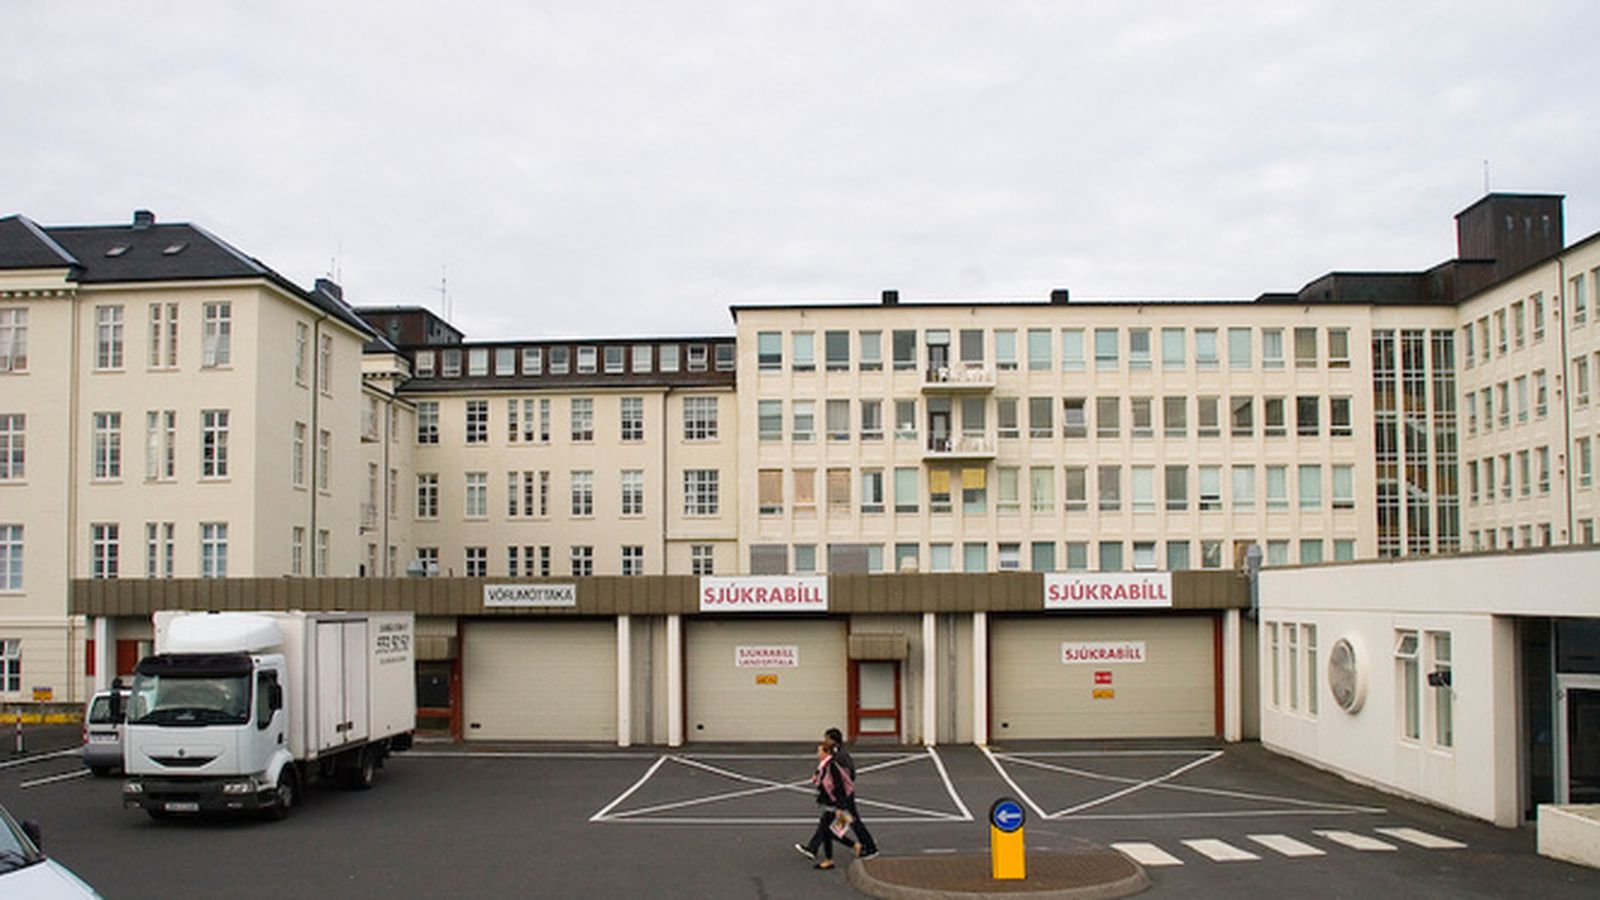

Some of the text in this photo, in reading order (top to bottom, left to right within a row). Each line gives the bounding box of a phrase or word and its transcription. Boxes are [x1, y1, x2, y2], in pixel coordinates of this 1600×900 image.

[703, 581, 824, 604] SJÚKRABÍLL
[1048, 579, 1168, 602] SJÚKRABÍLL
[1064, 644, 1142, 660] SJÚKRABÍLL
